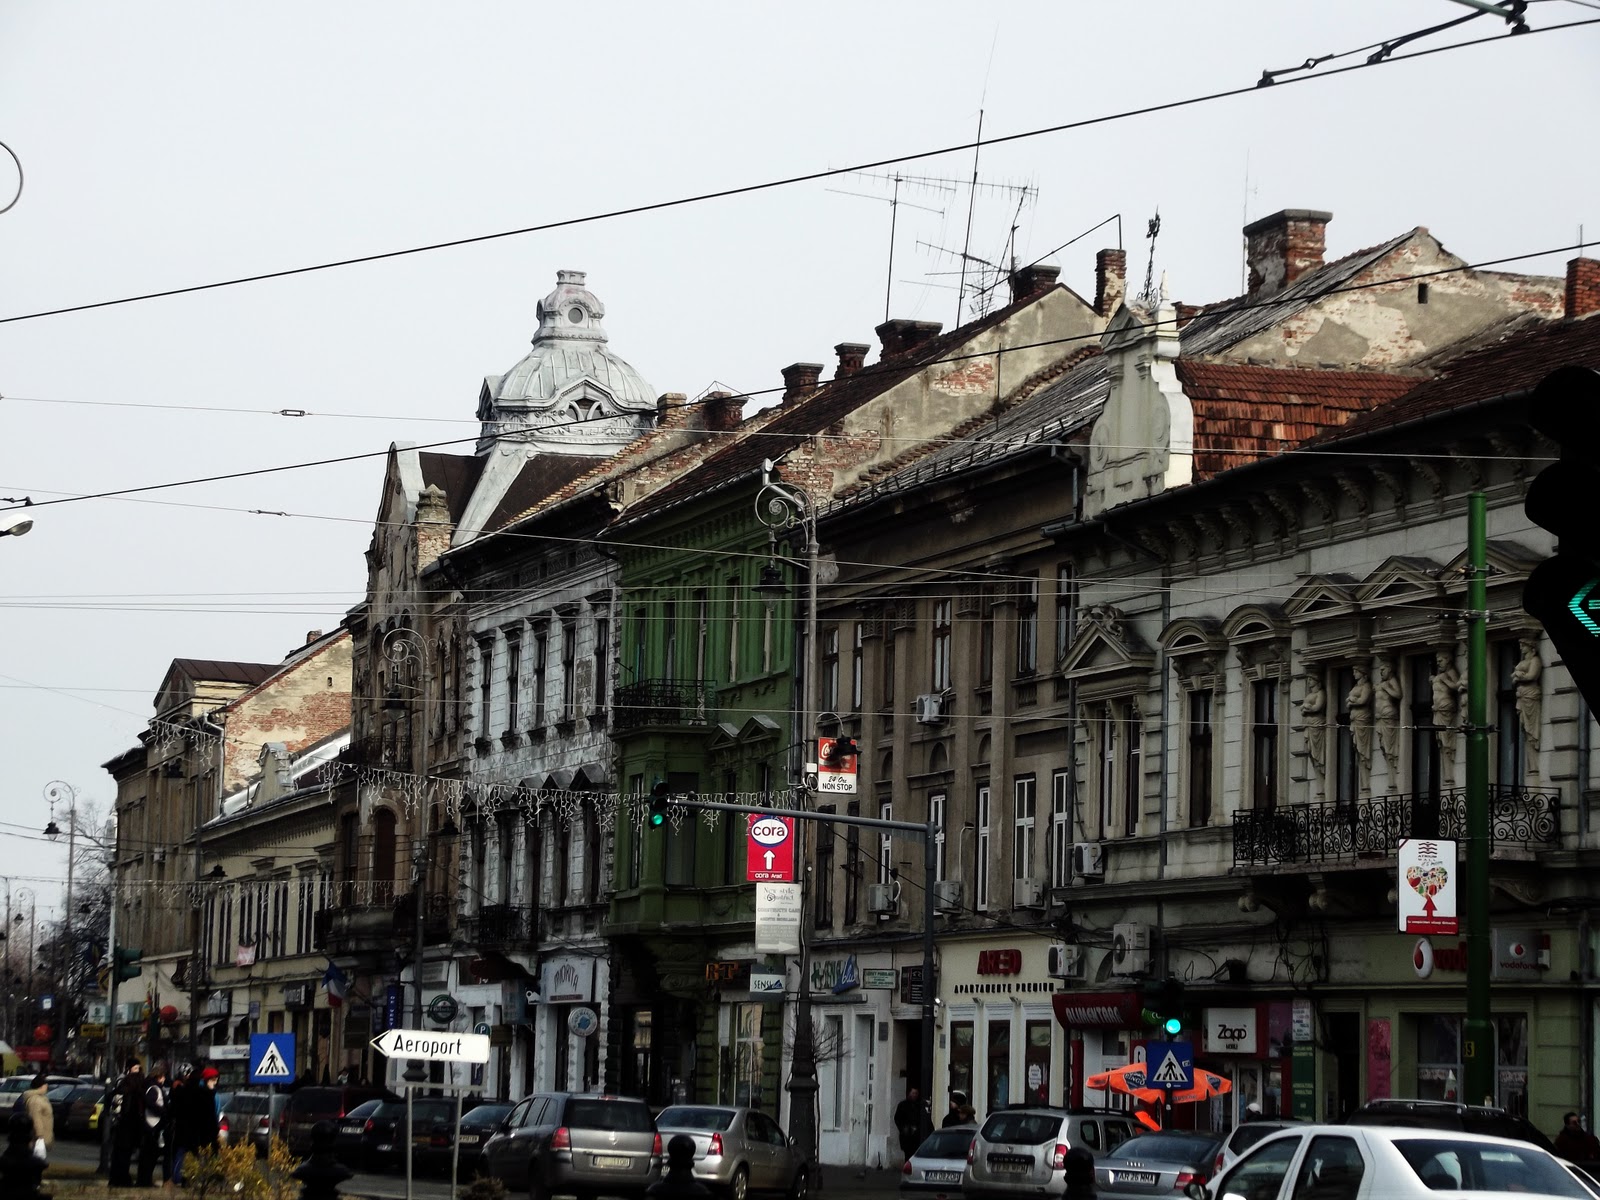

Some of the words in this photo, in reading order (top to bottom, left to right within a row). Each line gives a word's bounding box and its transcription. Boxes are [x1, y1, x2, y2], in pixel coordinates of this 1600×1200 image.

[828, 775, 837, 783] 24
[836, 783, 853, 791] STOP
[753, 826, 785, 837] cora
[954, 984, 1012, 994] APARTAMENTE
[1016, 983, 1055, 993] PREMIUM
[1065, 1006, 1124, 1024] ALIMENTARA
[1218, 1024, 1247, 1041] Zapp
[393, 1034, 462, 1057] Aeroport
[1118, 1172, 1130, 1181] AR
[1130, 1173, 1139, 1181] 26
